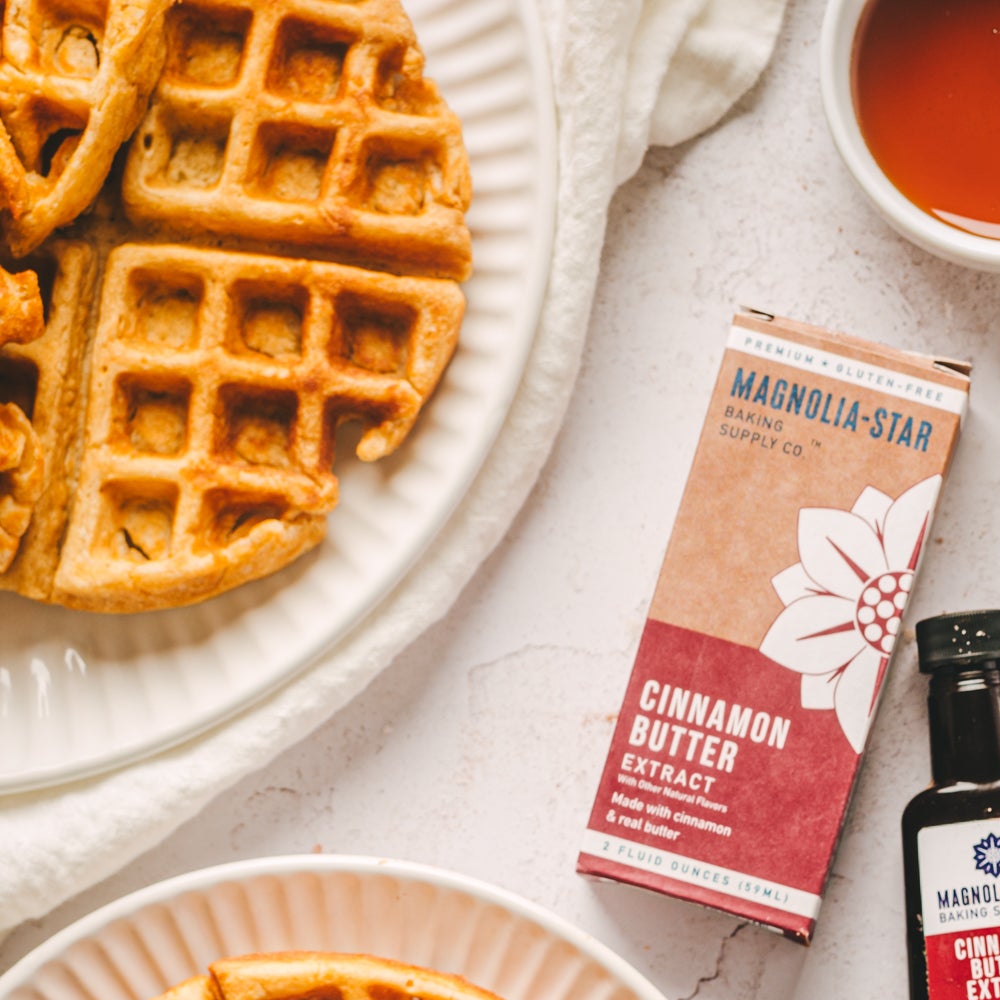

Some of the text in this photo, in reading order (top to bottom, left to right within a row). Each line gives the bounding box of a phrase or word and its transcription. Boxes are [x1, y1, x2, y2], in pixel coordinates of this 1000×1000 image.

[745, 337, 943, 402] PREMIUM GLUTEN-FREE
[725, 405, 784, 432] BAKING
[731, 368, 932, 452] MAGNOLIA-STAR
[719, 423, 777, 450] SUPPLY
[639, 679, 791, 749] CINNAMON
[629, 714, 739, 773] BUTTER
[618, 773, 728, 813] With Other Natural Flavors
[620, 753, 716, 794] EXTRACT
[606, 809, 681, 841] & real butter
[611, 792, 732, 836] Made with cinnamon
[603, 841, 789, 903] 2 FLUID OUNCES (59ML)
[939, 908, 988, 923] BAKING
